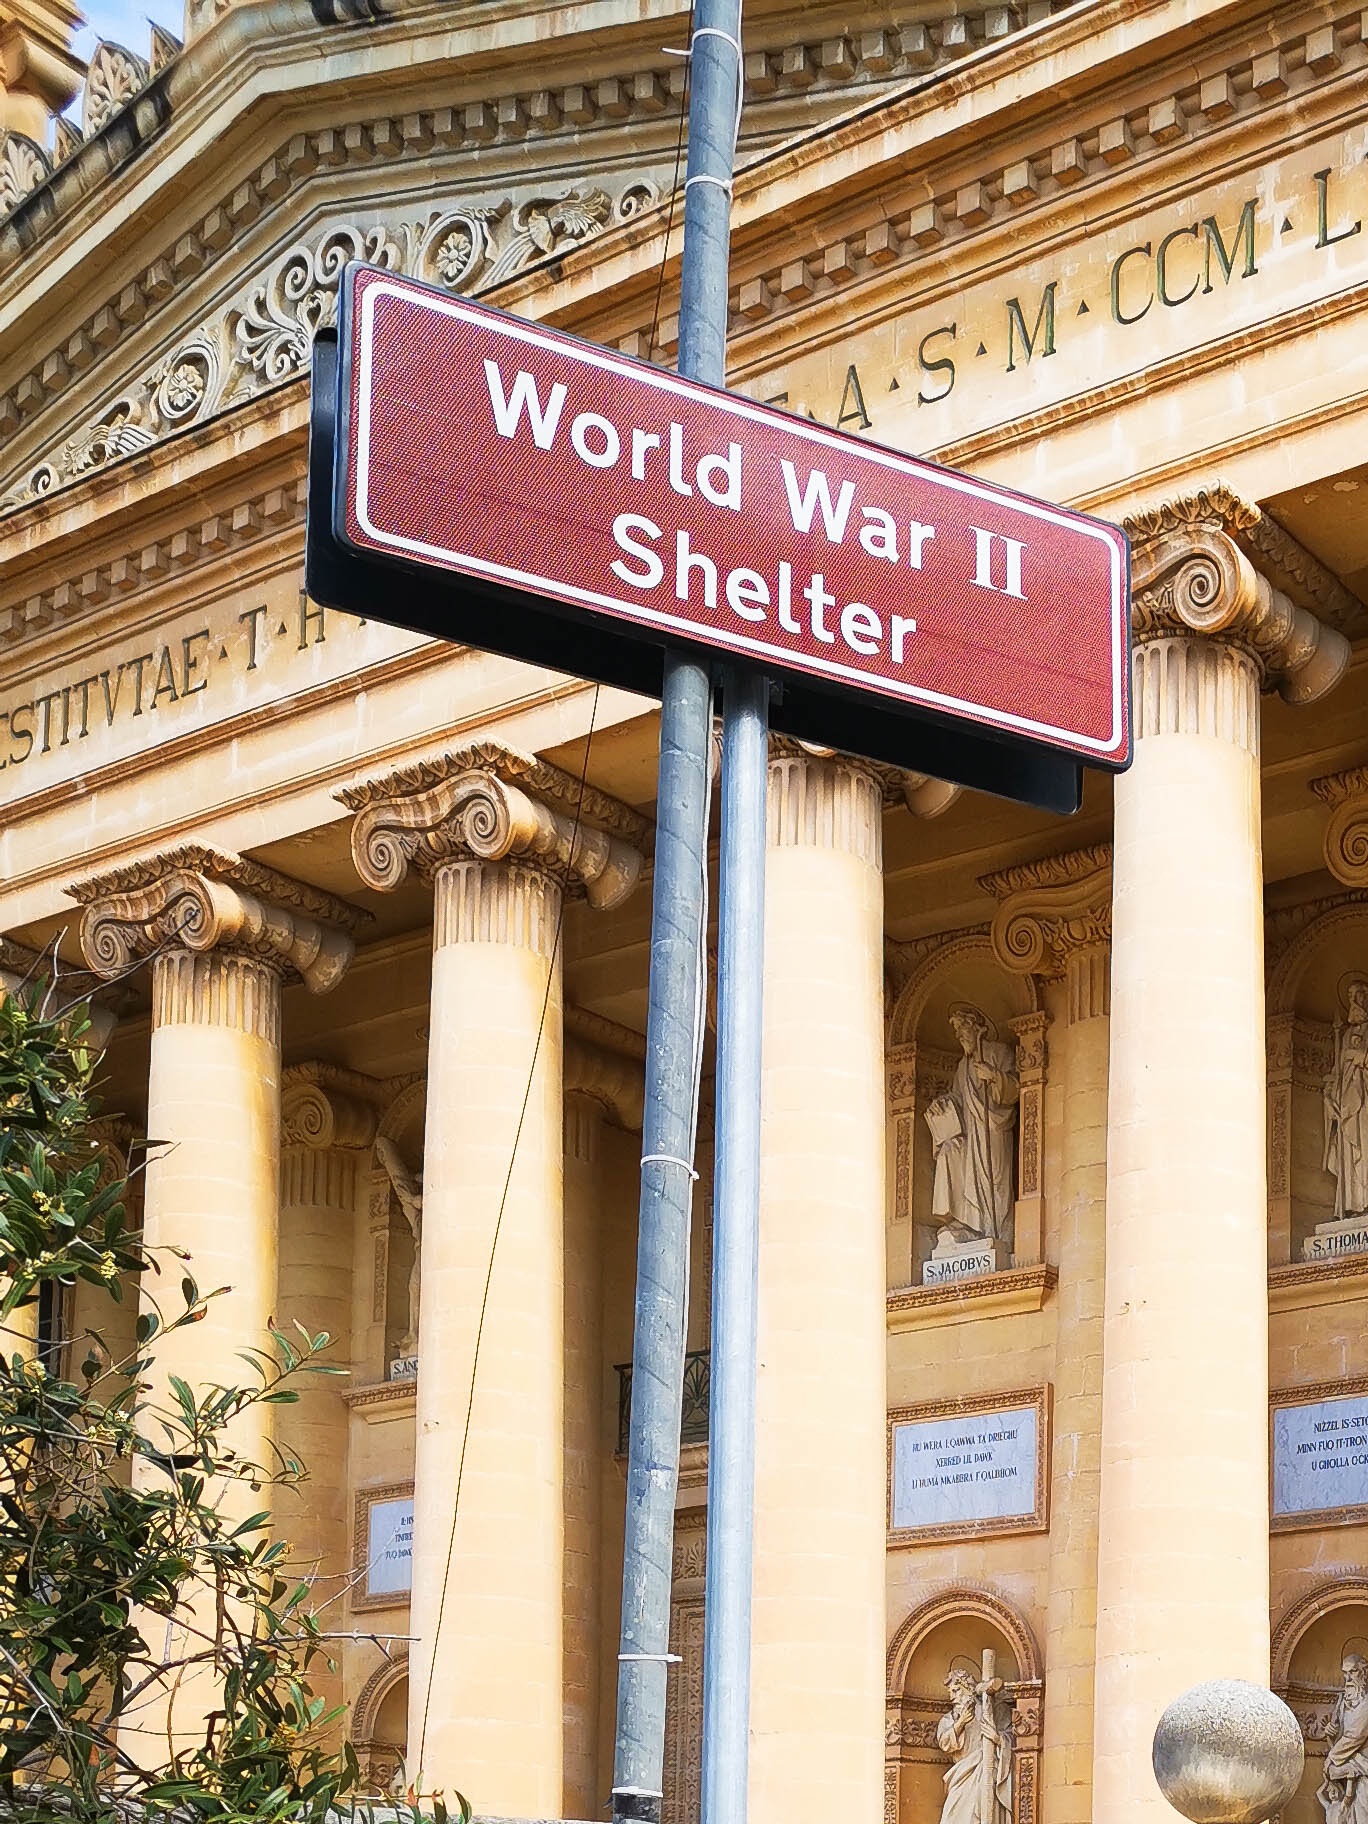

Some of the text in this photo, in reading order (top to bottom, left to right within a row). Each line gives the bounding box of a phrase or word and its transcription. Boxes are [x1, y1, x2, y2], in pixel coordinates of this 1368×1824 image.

[1005, 281, 1058, 373] M
[482, 359, 1030, 601] World War II
[610, 513, 918, 666] Shelter
